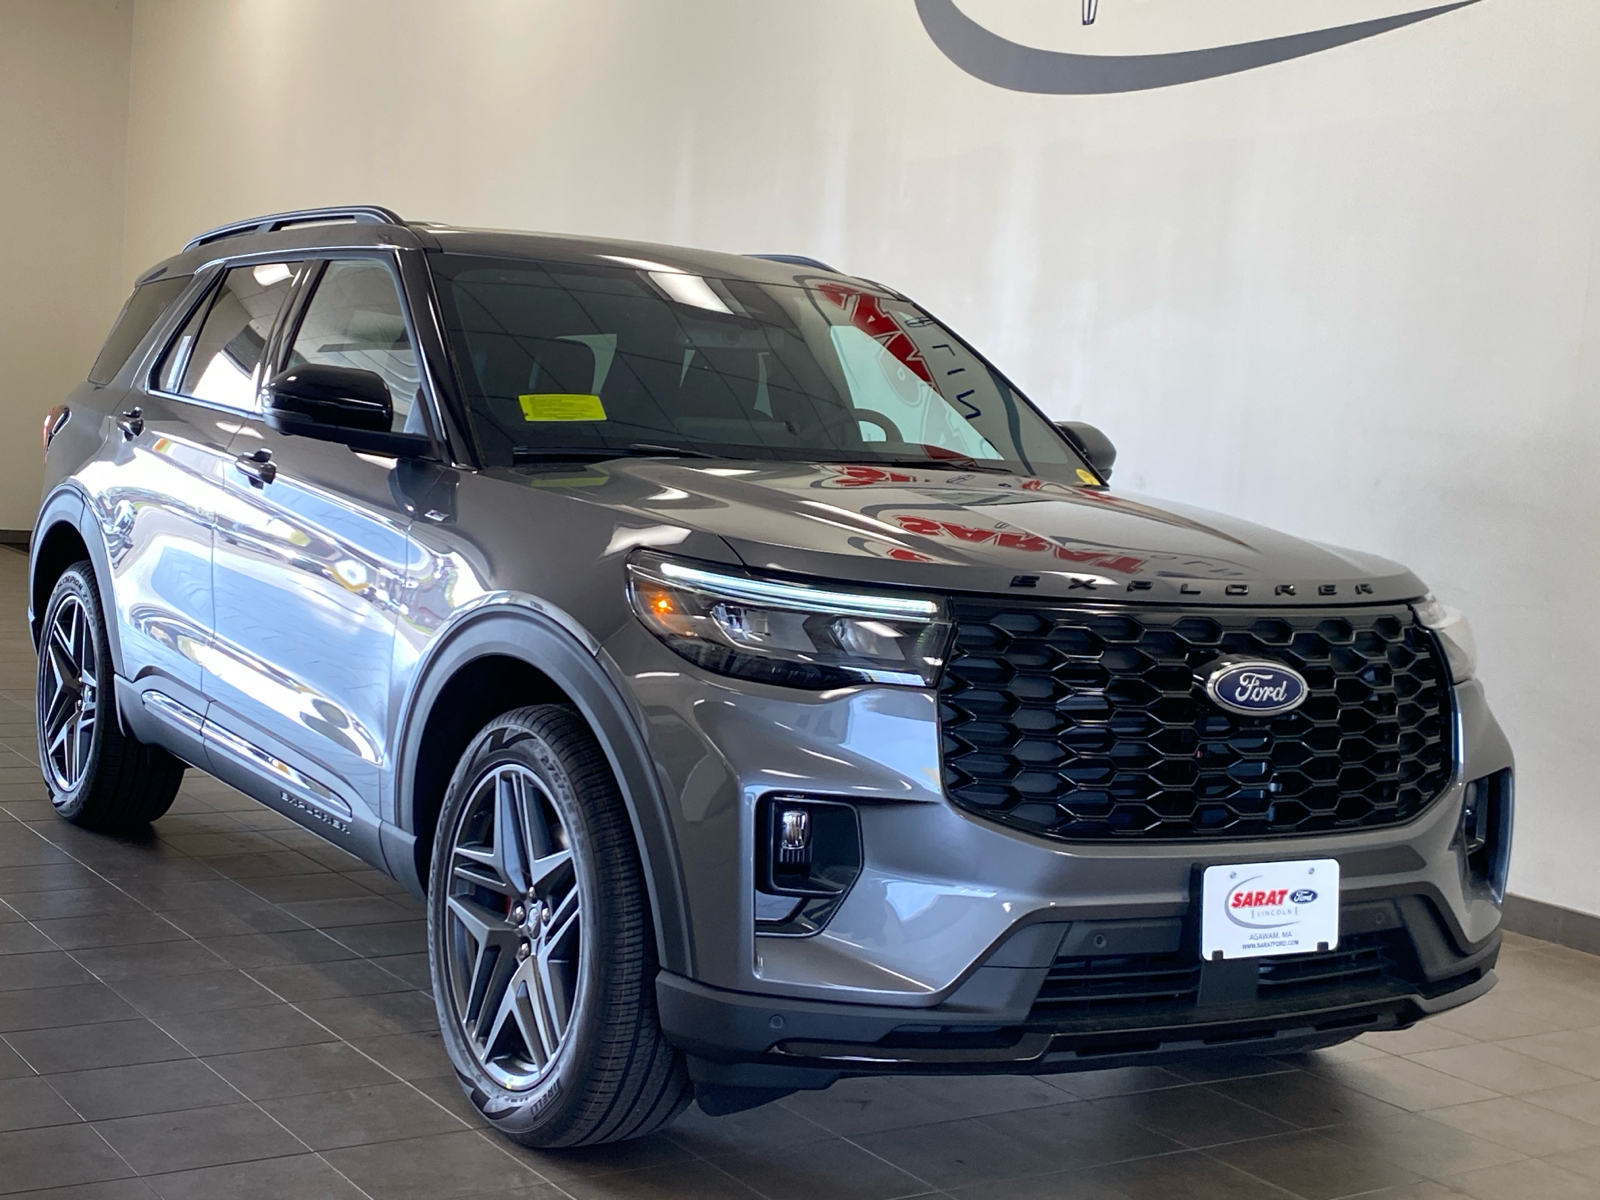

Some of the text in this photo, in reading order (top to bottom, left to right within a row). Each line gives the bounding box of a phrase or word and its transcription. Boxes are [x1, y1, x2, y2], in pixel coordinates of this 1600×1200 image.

[1010, 575, 1374, 596] EXPLORER
[1234, 672, 1288, 702] Ford
[1231, 889, 1315, 908] SARAT Ford
[1257, 909, 1292, 917] LINCOLN
